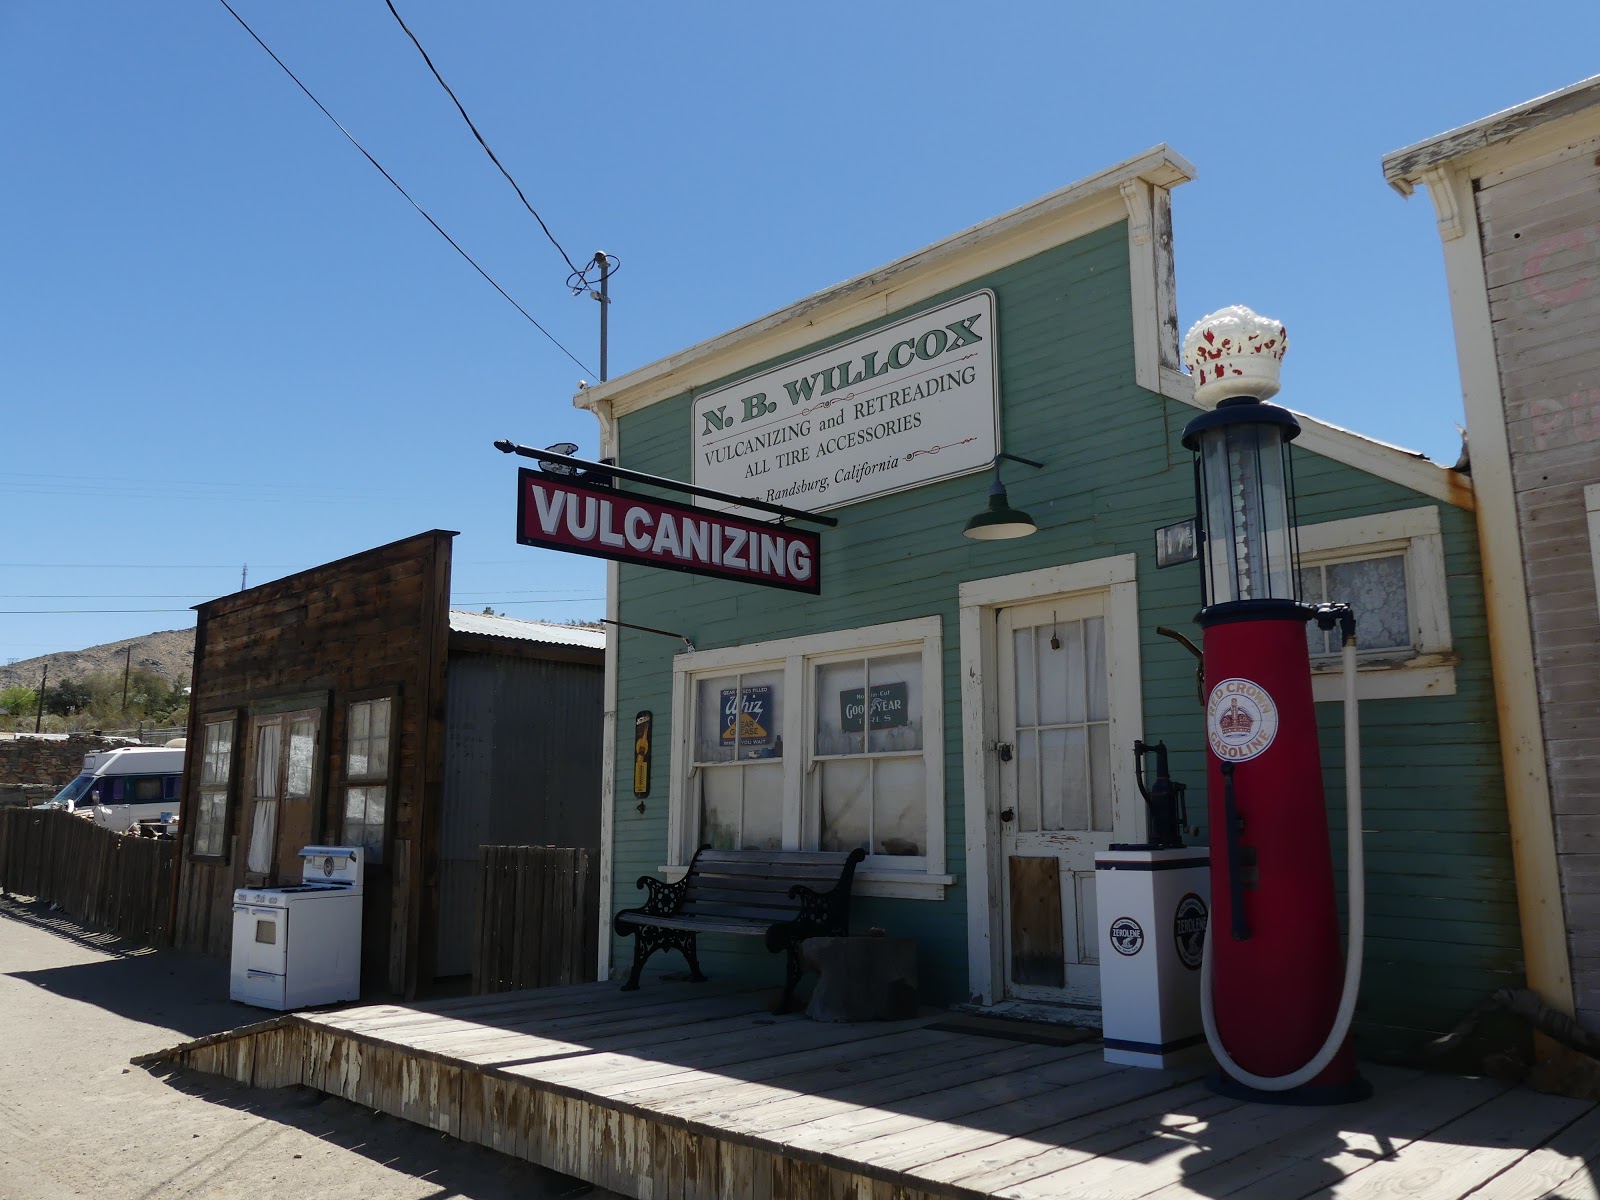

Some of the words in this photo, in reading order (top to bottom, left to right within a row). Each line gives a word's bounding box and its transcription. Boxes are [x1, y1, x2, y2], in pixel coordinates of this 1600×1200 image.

[701, 405, 734, 437] N.
[741, 392, 777, 423] B.
[783, 313, 983, 406] WILLCOX
[704, 420, 812, 467] VULCANIZING
[819, 409, 845, 432] and
[853, 366, 976, 421] RETREADING
[745, 459, 771, 479] ALL
[776, 447, 810, 470] TIRE
[816, 412, 923, 459] ACCESSORIES
[765, 476, 831, 503] Randsburg,
[834, 455, 900, 486] California
[531, 484, 812, 582] VULCANIZING
[725, 694, 764, 715] Whiz
[846, 699, 902, 719] GOOYEAR
[1208, 688, 1224, 717] RED
[1226, 682, 1272, 714] CROWN
[729, 727, 759, 736] GEASE
[735, 720, 754, 728] EAR
[858, 714, 891, 725] TRES
[1210, 729, 1272, 758] GASOLINE
[1112, 928, 1141, 938] ZEROLENE
